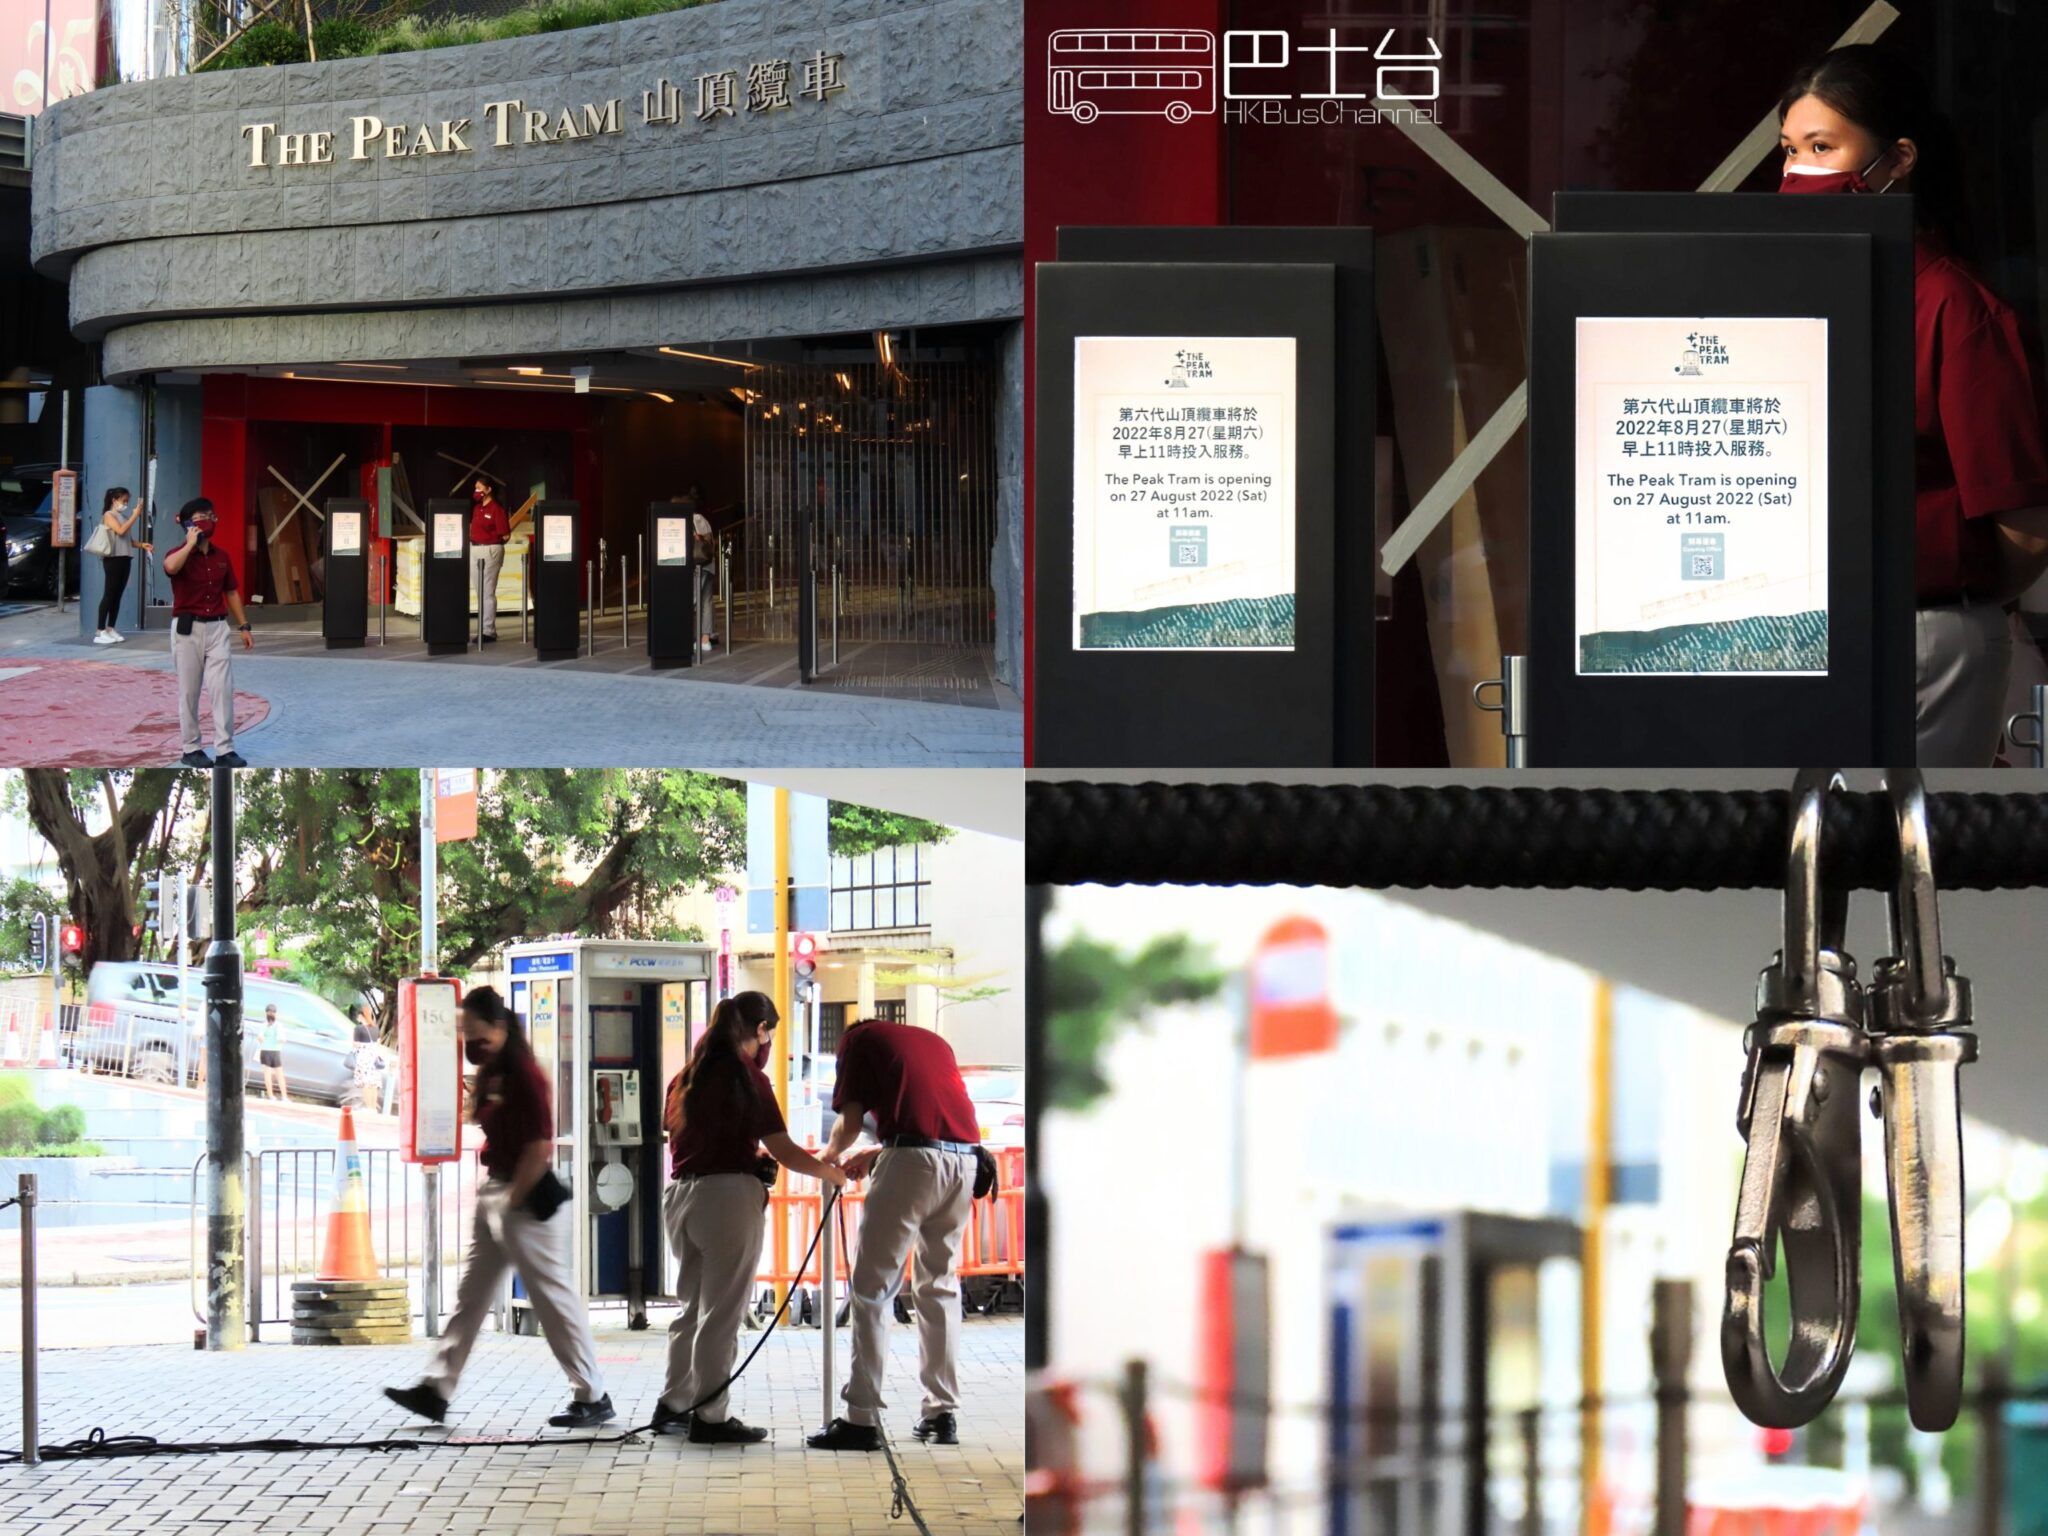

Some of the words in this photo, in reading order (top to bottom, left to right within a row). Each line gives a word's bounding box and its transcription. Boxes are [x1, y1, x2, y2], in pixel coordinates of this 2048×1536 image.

[242, 123, 334, 167] THE
[349, 115, 473, 160] PEAK
[484, 99, 625, 147] TRAM
[642, 49, 846, 125] 山頂纜車
[1699, 335, 1719, 345] THE
[1186, 352, 1204, 361] THE
[1699, 346, 1727, 355] PEAK
[1186, 361, 1211, 370] PEAK
[1699, 355, 1730, 365] TRAM
[1187, 370, 1213, 378] TRAM
[1118, 406, 1258, 422] 第六代山頂纜車將於
[1623, 397, 1782, 416] 第六代山頂纜車將於
[1112, 425, 1264, 441] 2022年8月27(星期六)
[1615, 418, 1788, 437] 2022年8月27(星期六)
[1118, 444, 1252, 460] 早上11時投入服務。
[1621, 439, 1773, 458] 早上11時投入服務。
[1104, 473, 1129, 486] The
[1132, 473, 1164, 486] Peak
[1167, 473, 1201, 486] Tram
[1204, 473, 1215, 486] is
[1218, 473, 1272, 487] opening
[1606, 473, 1635, 487] The
[1639, 473, 1675, 487] Peak
[1678, 473, 1717, 487] Tram
[1720, 473, 1732, 487] is
[1735, 473, 1798, 490] opening
[1110, 492, 1127, 503] on
[1130, 490, 1147, 503] 27
[1150, 490, 1196, 505] August
[1200, 489, 1234, 502] 2022
[1237, 489, 1268, 504] (Sat)
[1613, 495, 1632, 506] on
[1636, 492, 1655, 506] 27
[1658, 492, 1712, 509] August
[1715, 491, 1754, 506] 2022
[1758, 491, 1793, 508] (Sat)
[1156, 508, 1170, 519] at
[1173, 507, 1213, 519] 11am.
[1666, 513, 1681, 525] at
[1687, 511, 1731, 525] 11am.
[629, 959, 657, 967] PCCW
